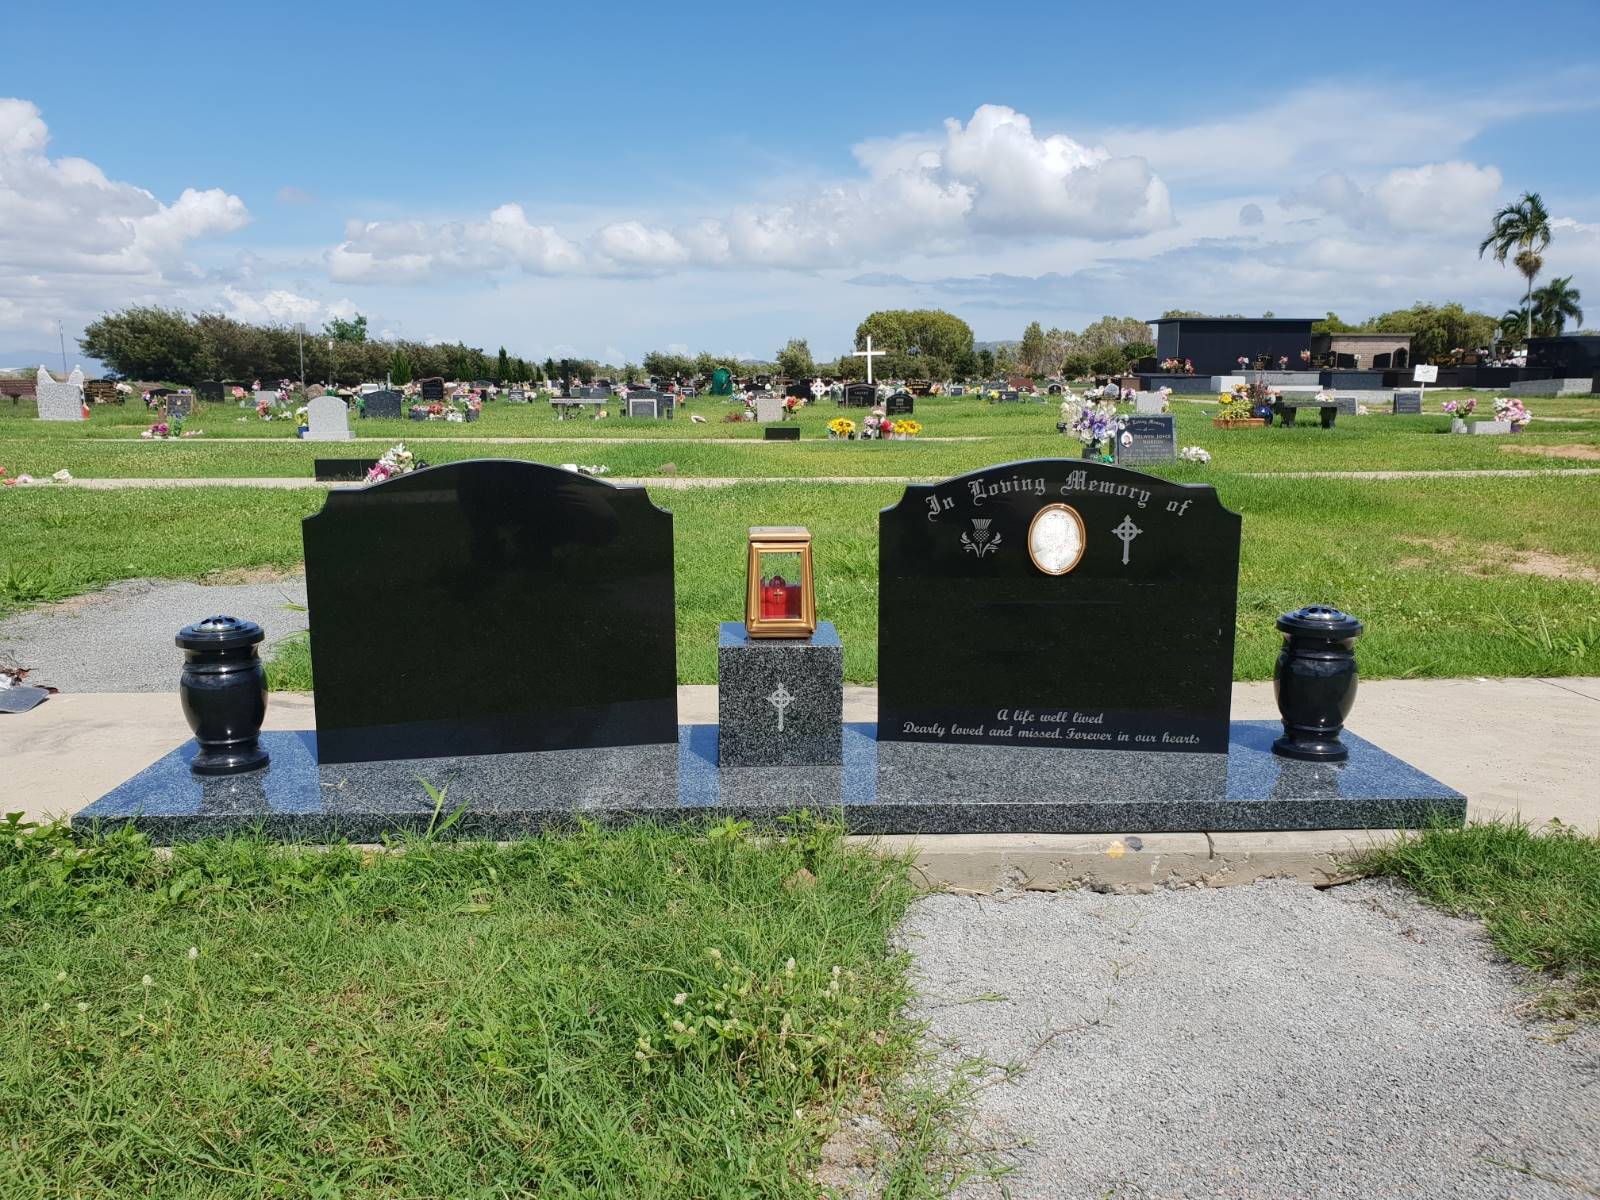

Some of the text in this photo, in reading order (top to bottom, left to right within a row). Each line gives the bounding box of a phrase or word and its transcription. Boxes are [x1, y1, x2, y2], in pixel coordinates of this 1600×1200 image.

[925, 469, 1194, 522] In Loving Memory of
[996, 708, 1104, 725] A life well lived
[902, 720, 1200, 744] Dearly loved and missed. Forever in our hearts
